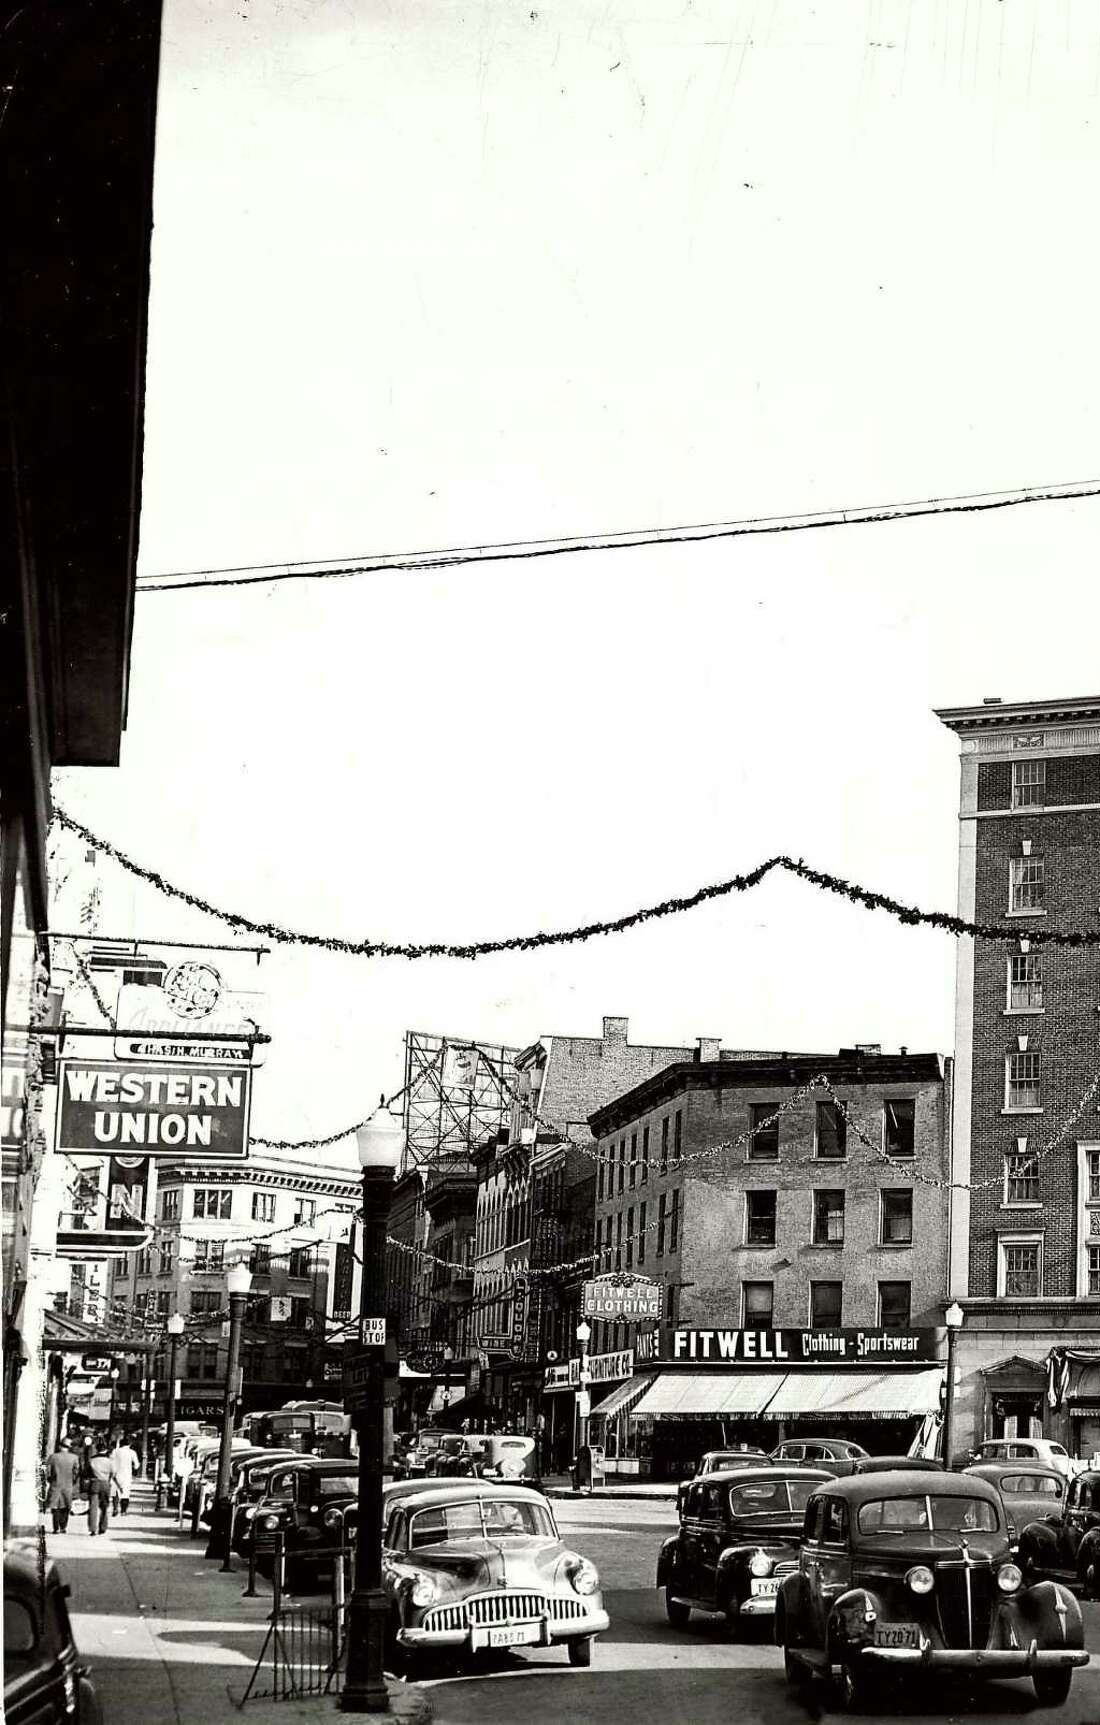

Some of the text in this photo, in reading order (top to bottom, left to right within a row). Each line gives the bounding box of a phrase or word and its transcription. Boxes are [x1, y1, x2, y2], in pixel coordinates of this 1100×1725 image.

[66, 1070, 242, 1107] WESTERN
[94, 1111, 212, 1146] UNION
[593, 1287, 653, 1299] FITWELL
[587, 1299, 658, 1313] CLOTHING
[365, 1319, 384, 1331] BUS
[363, 1332, 385, 1345] STOP
[674, 1331, 789, 1358] FITWELL
[802, 1332, 846, 1357] Clothing
[857, 1332, 920, 1356] Sportswear
[179, 1405, 224, 1416] IGARS
